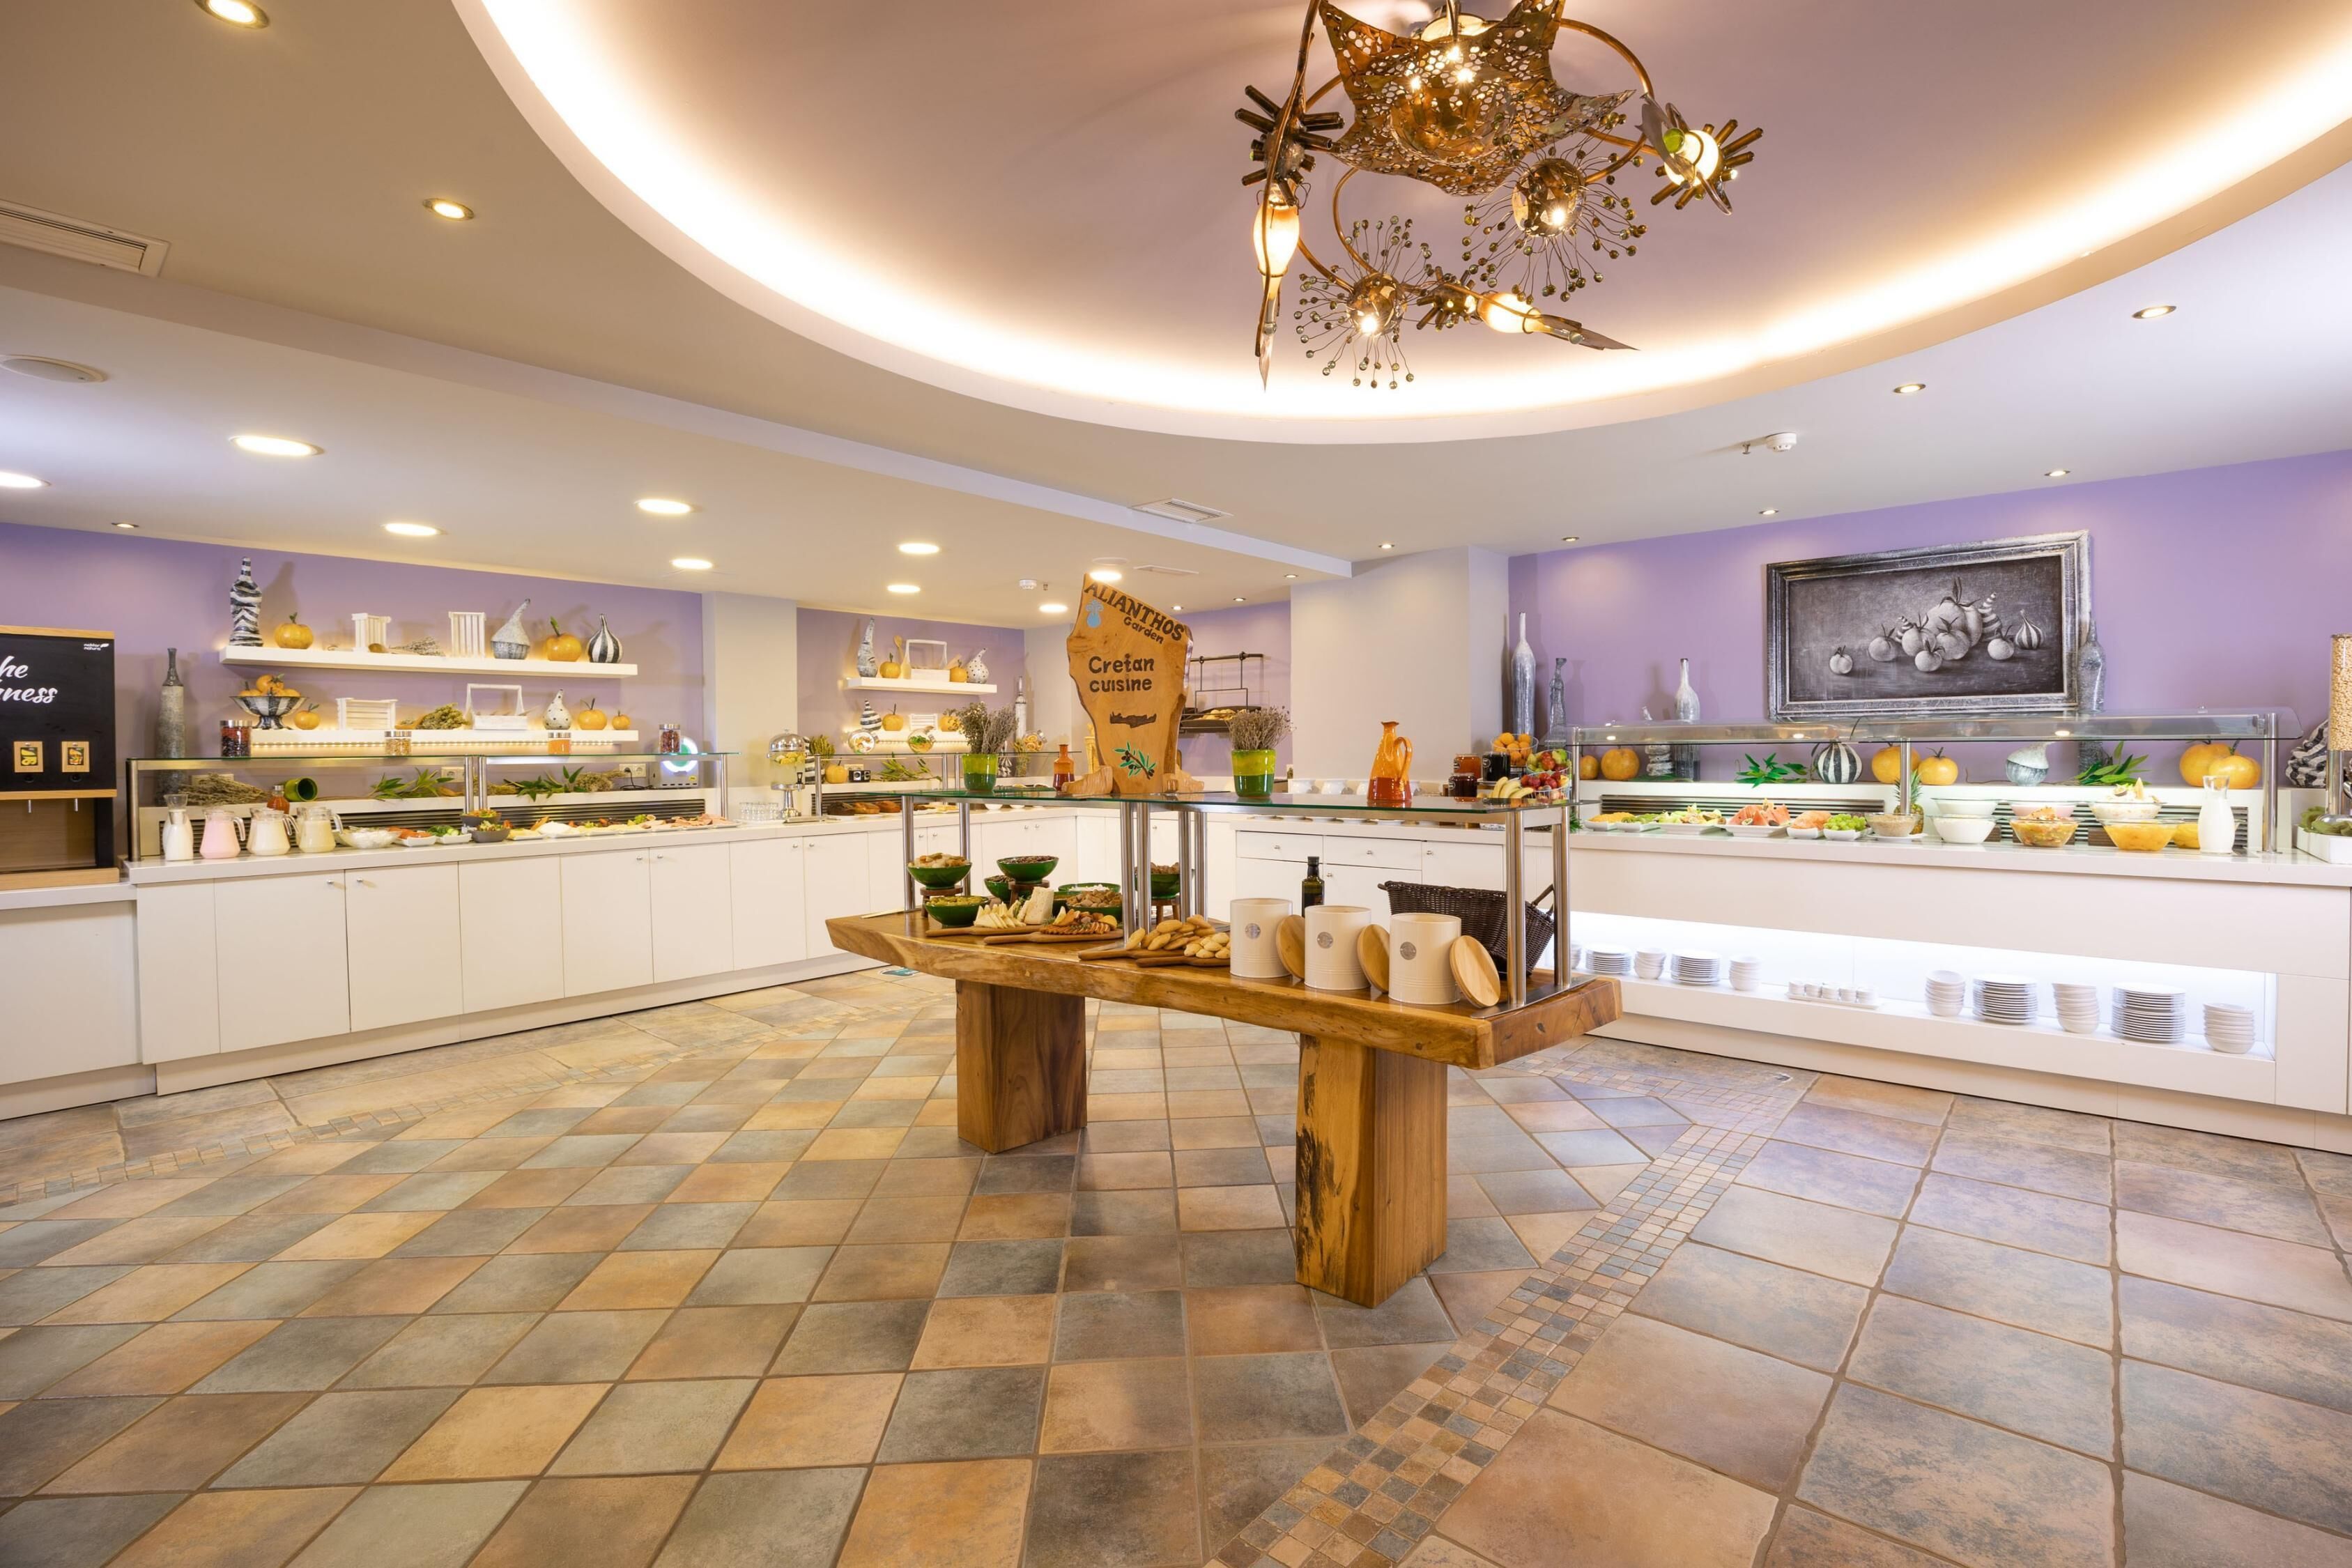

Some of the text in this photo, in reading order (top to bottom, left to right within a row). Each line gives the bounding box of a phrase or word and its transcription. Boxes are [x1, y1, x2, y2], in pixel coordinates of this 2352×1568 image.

[1084, 582, 1185, 641] ALIANTHOS
[1123, 616, 1165, 644] Garden
[1089, 654, 1155, 674] Cretan
[0, 687, 58, 703] ness
[1089, 678, 1153, 693] cuisine
